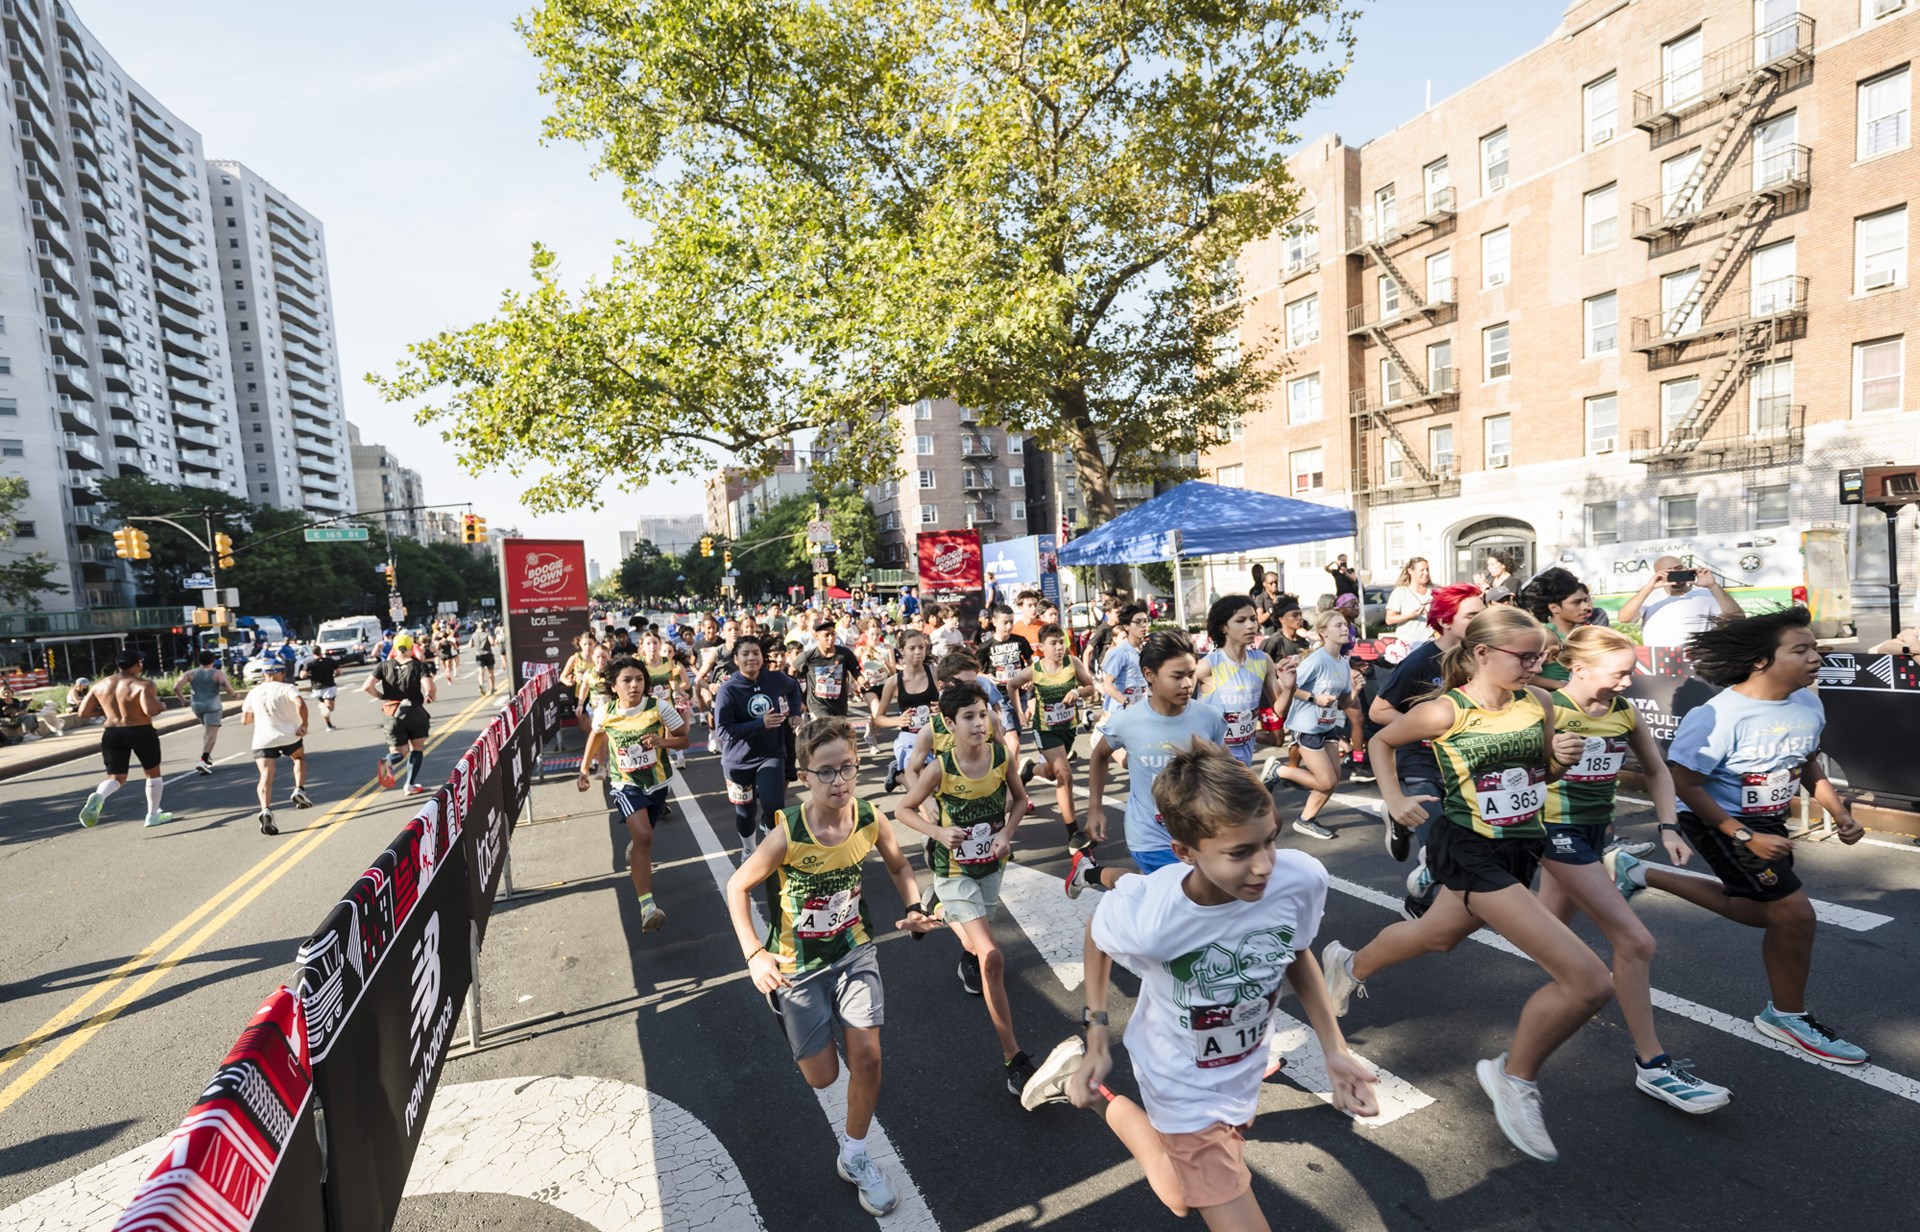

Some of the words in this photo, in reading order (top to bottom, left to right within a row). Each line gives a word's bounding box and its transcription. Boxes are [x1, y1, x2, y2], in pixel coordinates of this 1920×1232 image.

[1633, 543, 1694, 555] AMBULANCE
[528, 559, 564, 580] BOOGIE
[1613, 559, 1650, 574] RCA
[532, 568, 563, 587] DOWN
[530, 615, 547, 627] tcs
[1047, 714, 1054, 722] A
[1056, 711, 1072, 721] 1101
[1225, 727, 1234, 737] A
[620, 759, 627, 768] A
[632, 754, 649, 766] 178
[1585, 757, 1612, 772] 185
[1485, 797, 1499, 815] A
[1510, 789, 1539, 812] 363
[1746, 790, 1759, 805] B
[1770, 785, 1793, 802] 825
[956, 846, 966, 858] A
[802, 913, 816, 929] A
[827, 904, 852, 927] 362
[1202, 1036, 1222, 1057] A
[404, 1067, 425, 1138] new
[422, 995, 454, 1086] balance
